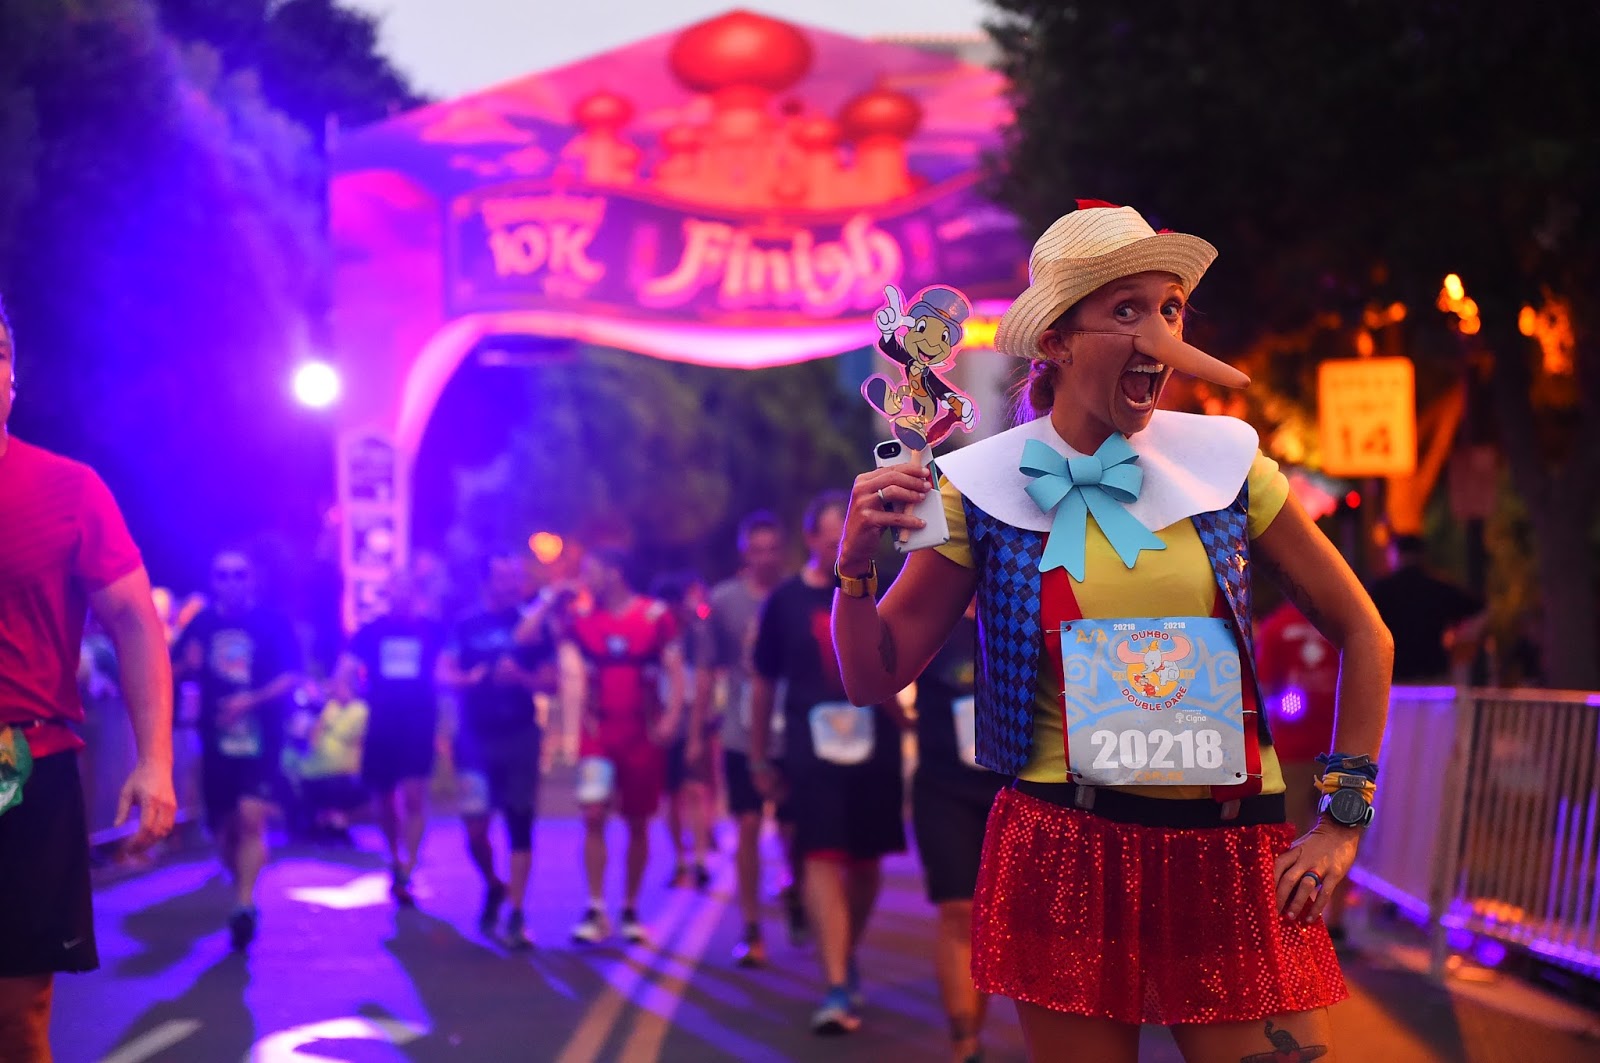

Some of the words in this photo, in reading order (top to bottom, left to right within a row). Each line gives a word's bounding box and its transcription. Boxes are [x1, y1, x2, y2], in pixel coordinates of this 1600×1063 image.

[488, 222, 606, 286] 10K
[636, 213, 904, 316] Finish
[1341, 423, 1393, 461] 14
[1113, 623, 1136, 631] 20218
[1163, 622, 1186, 630] 20218
[1131, 630, 1169, 641] DUMBO
[1121, 688, 1163, 711] DOUBLE
[1165, 685, 1187, 709] DARE
[1185, 714, 1207, 724] Cigna
[1090, 729, 1224, 770] 20218
